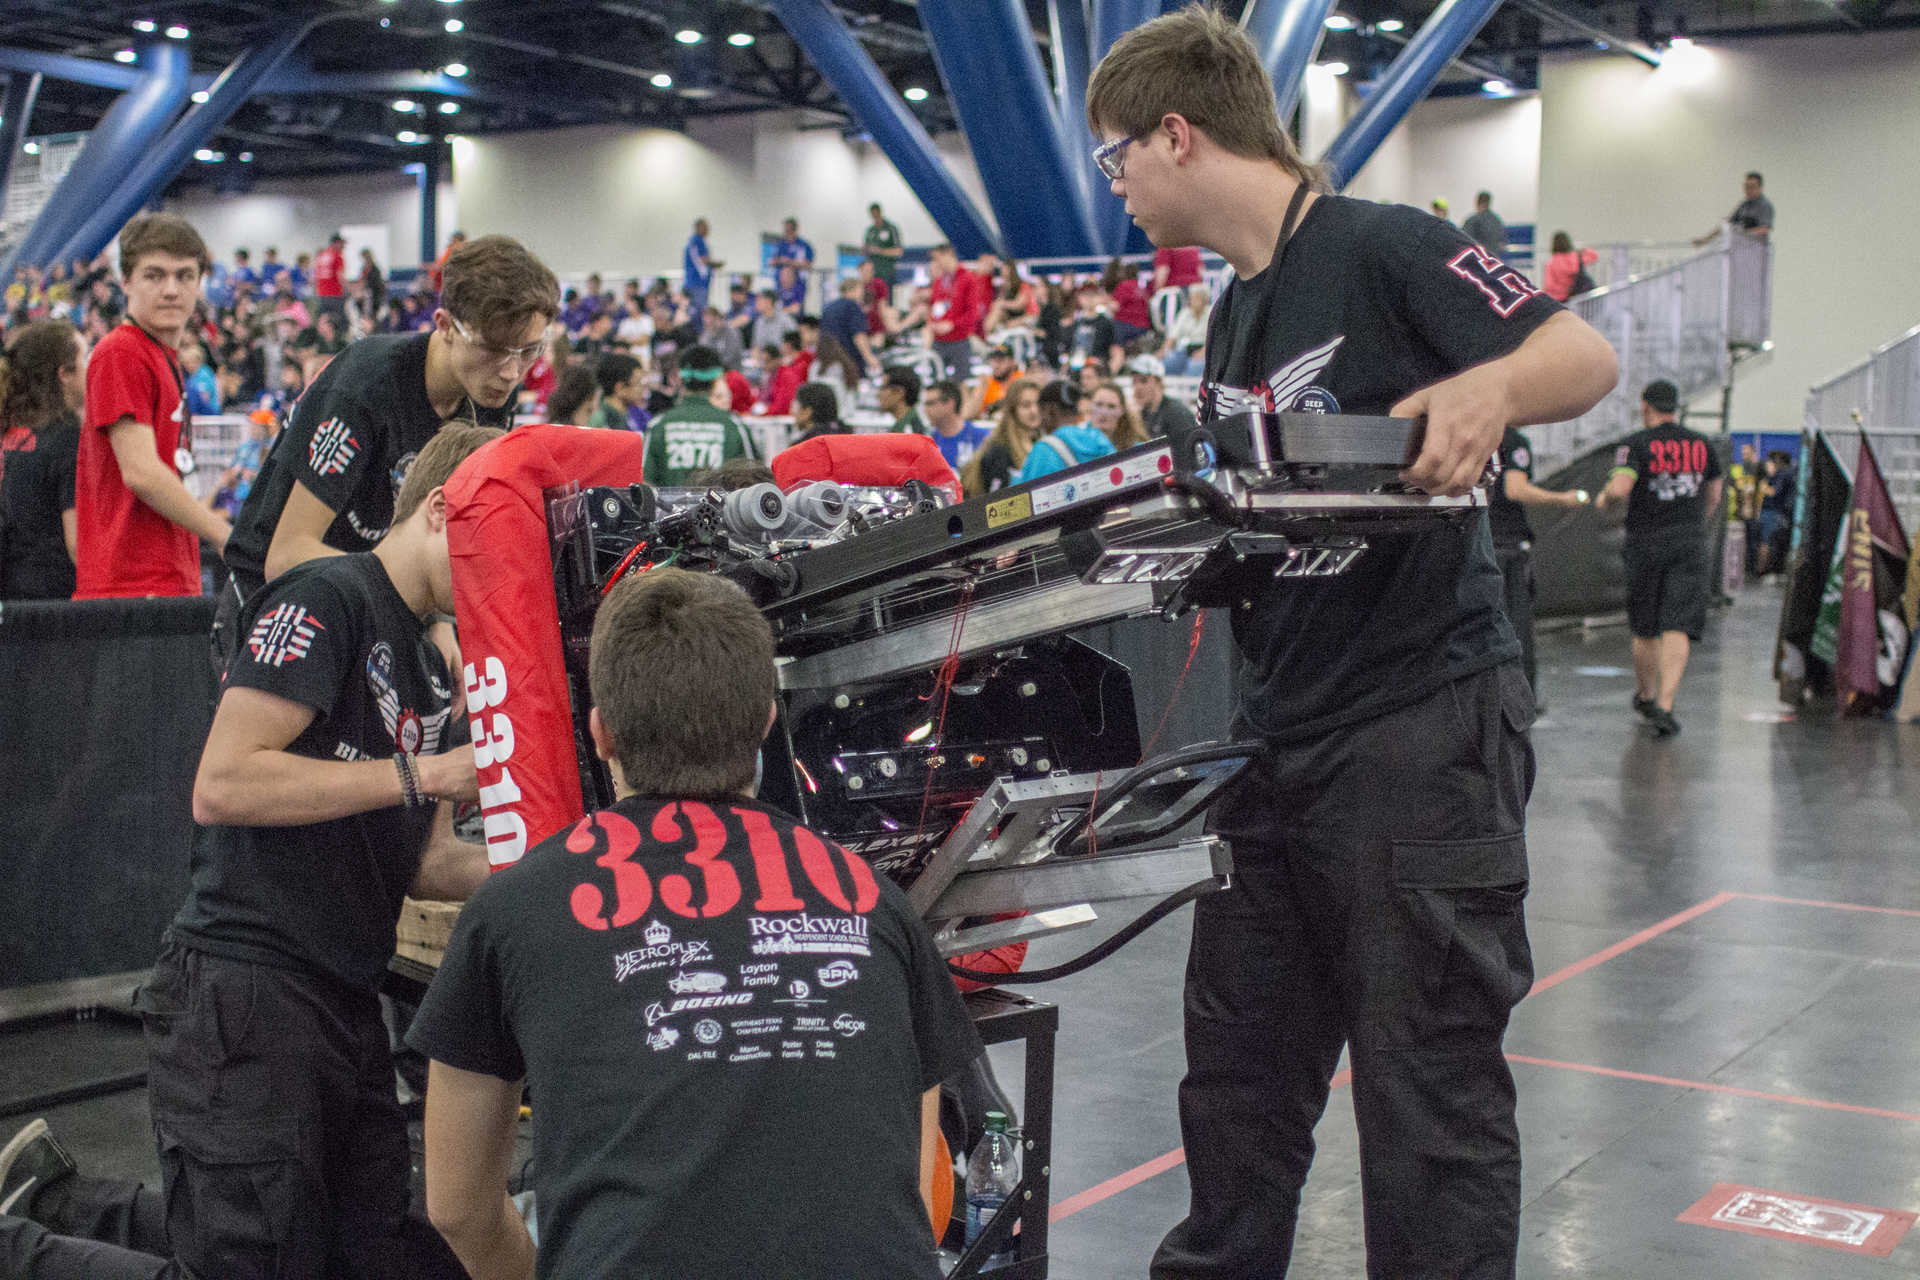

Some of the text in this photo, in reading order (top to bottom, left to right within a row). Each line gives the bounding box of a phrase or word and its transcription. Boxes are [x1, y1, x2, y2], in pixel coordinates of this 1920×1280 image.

[1304, 400, 1324, 408] DEEP
[1648, 439, 1708, 474] 3310
[463, 656, 528, 866] 3310
[565, 800, 880, 931] 3310
[748, 912, 868, 936] Rockwall
[615, 940, 710, 967] METROPLEX
[740, 962, 779, 975] Layton
[743, 974, 780, 986] Family
[670, 992, 754, 1012] BOEING
[796, 1017, 826, 1027] TRINITY
[833, 1018, 866, 1032] ONCOR
